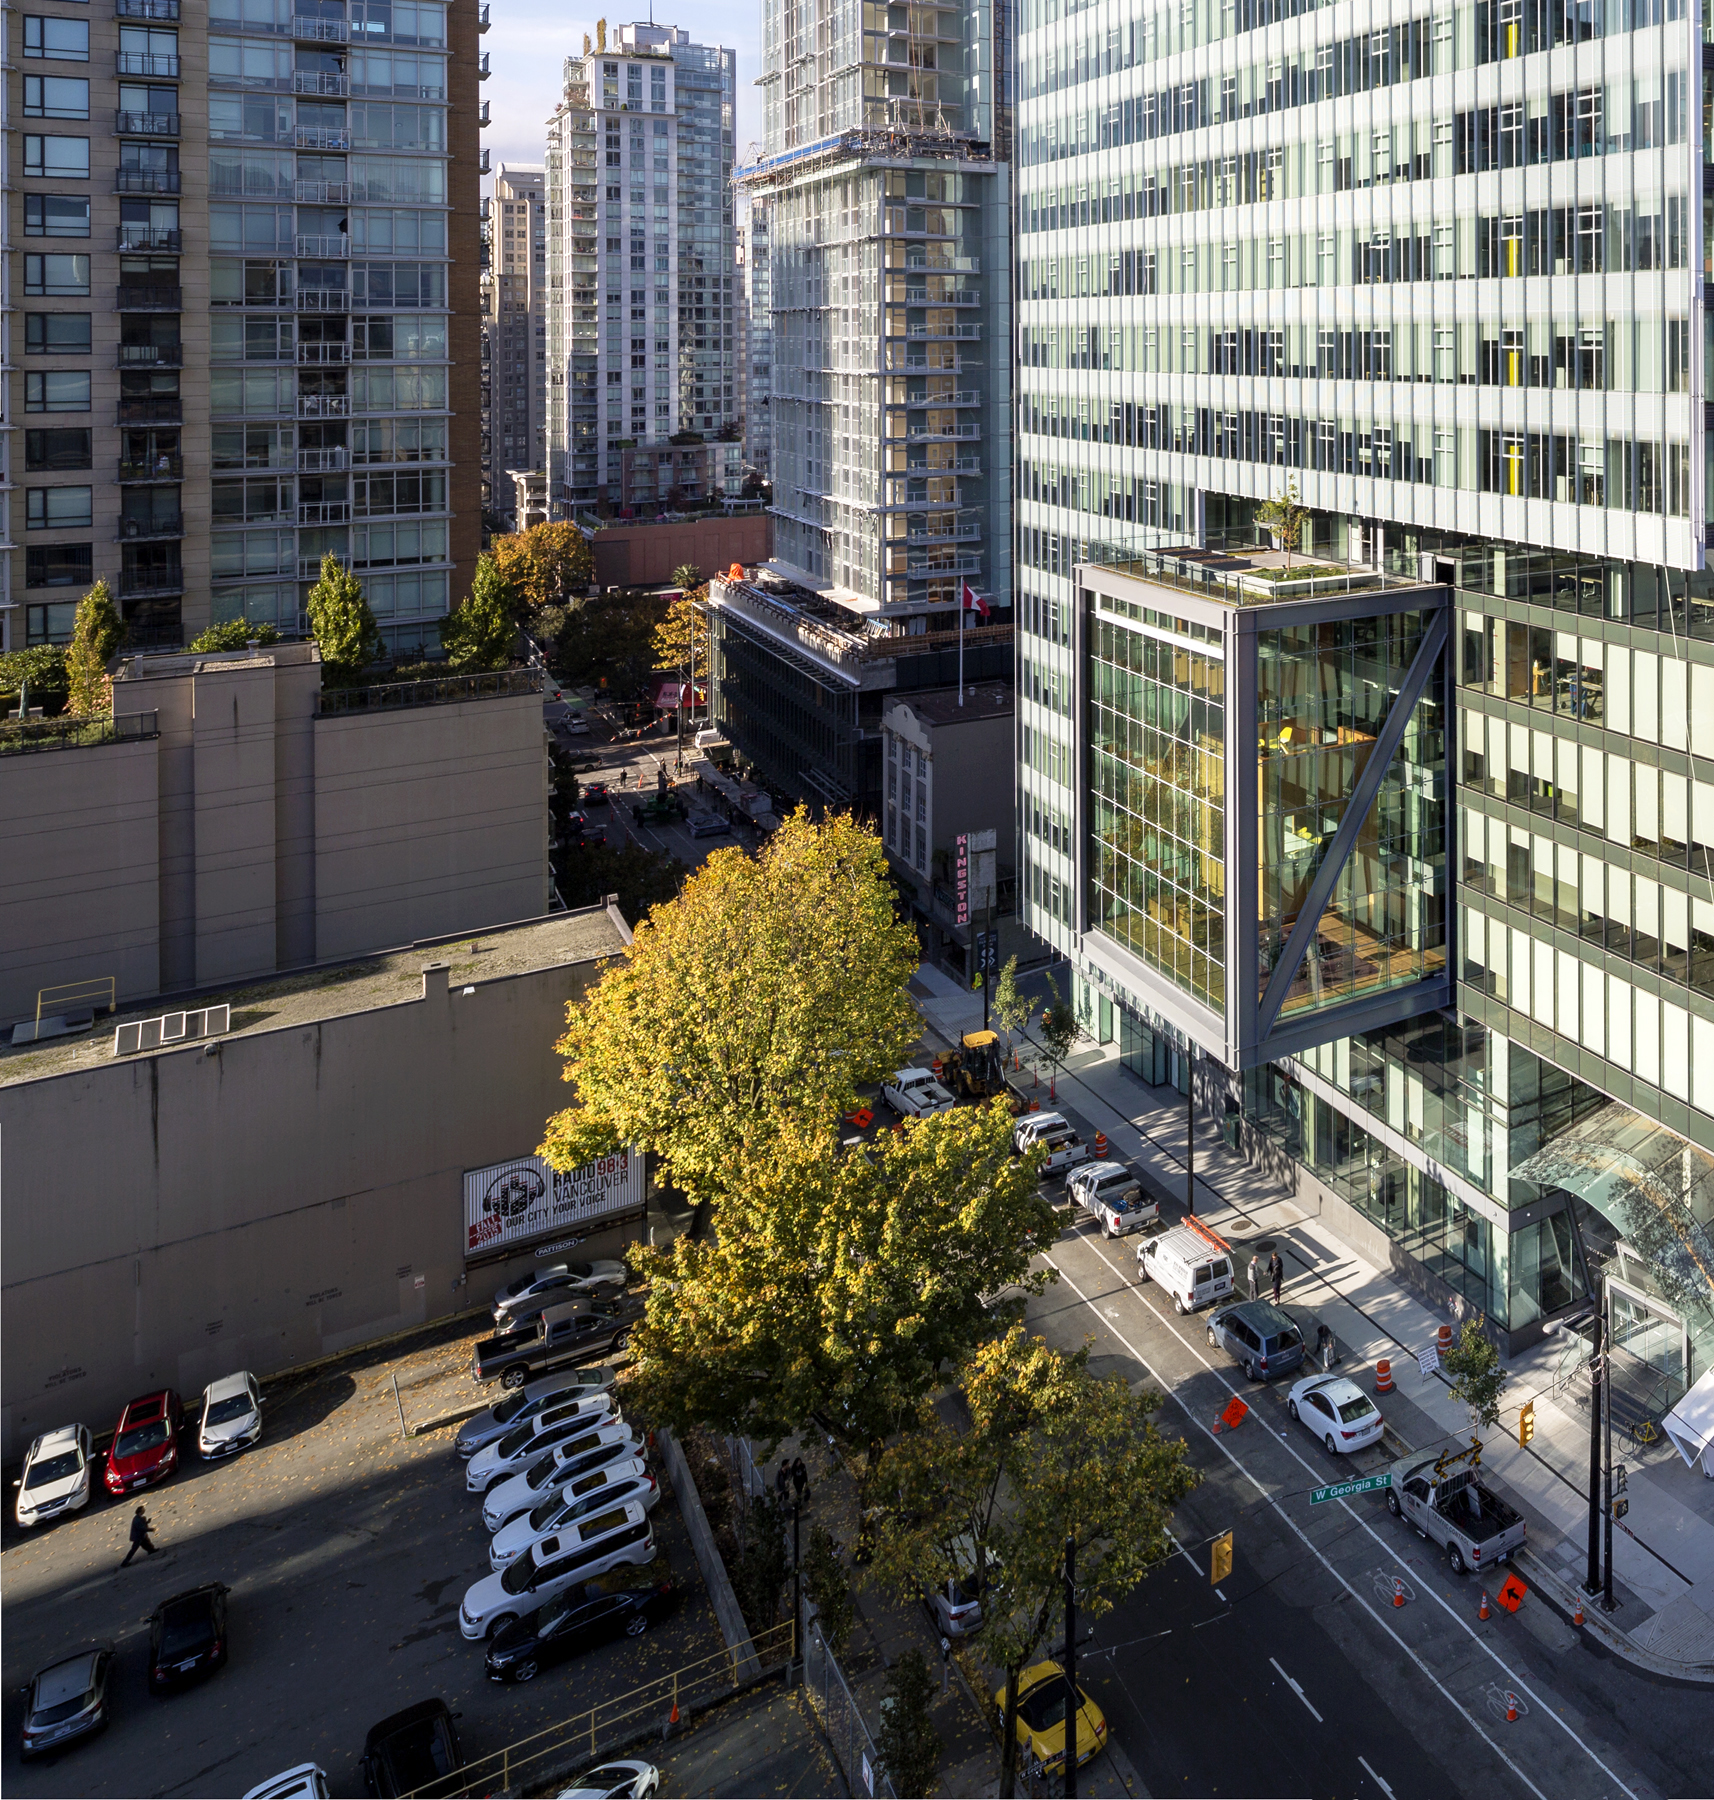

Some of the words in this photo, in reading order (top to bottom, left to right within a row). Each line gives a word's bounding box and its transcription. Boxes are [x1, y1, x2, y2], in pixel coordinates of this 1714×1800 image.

[957, 834, 968, 924] KINGSTON
[554, 1163, 595, 1187] RADIO
[554, 1171, 628, 1202] VANCOUVER
[506, 1214, 525, 1228] OUR
[528, 1207, 549, 1222] CITY
[552, 1200, 576, 1214] YOUR
[579, 1191, 606, 1207] VOICE
[476, 1215, 498, 1231] FALL
[538, 1240, 575, 1255] PATTISON
[309, 1287, 338, 1299] VIOLATORS
[326, 1291, 343, 1301] TOWED
[49, 1366, 82, 1381] VIOLATORS
[1316, 1489, 1326, 1500] W
[1330, 1480, 1371, 1497] Georgia
[1375, 1476, 1387, 1486] St
[1432, 1512, 1449, 1529] TRAFFIC
[1449, 1527, 1469, 1546] CONTROL
